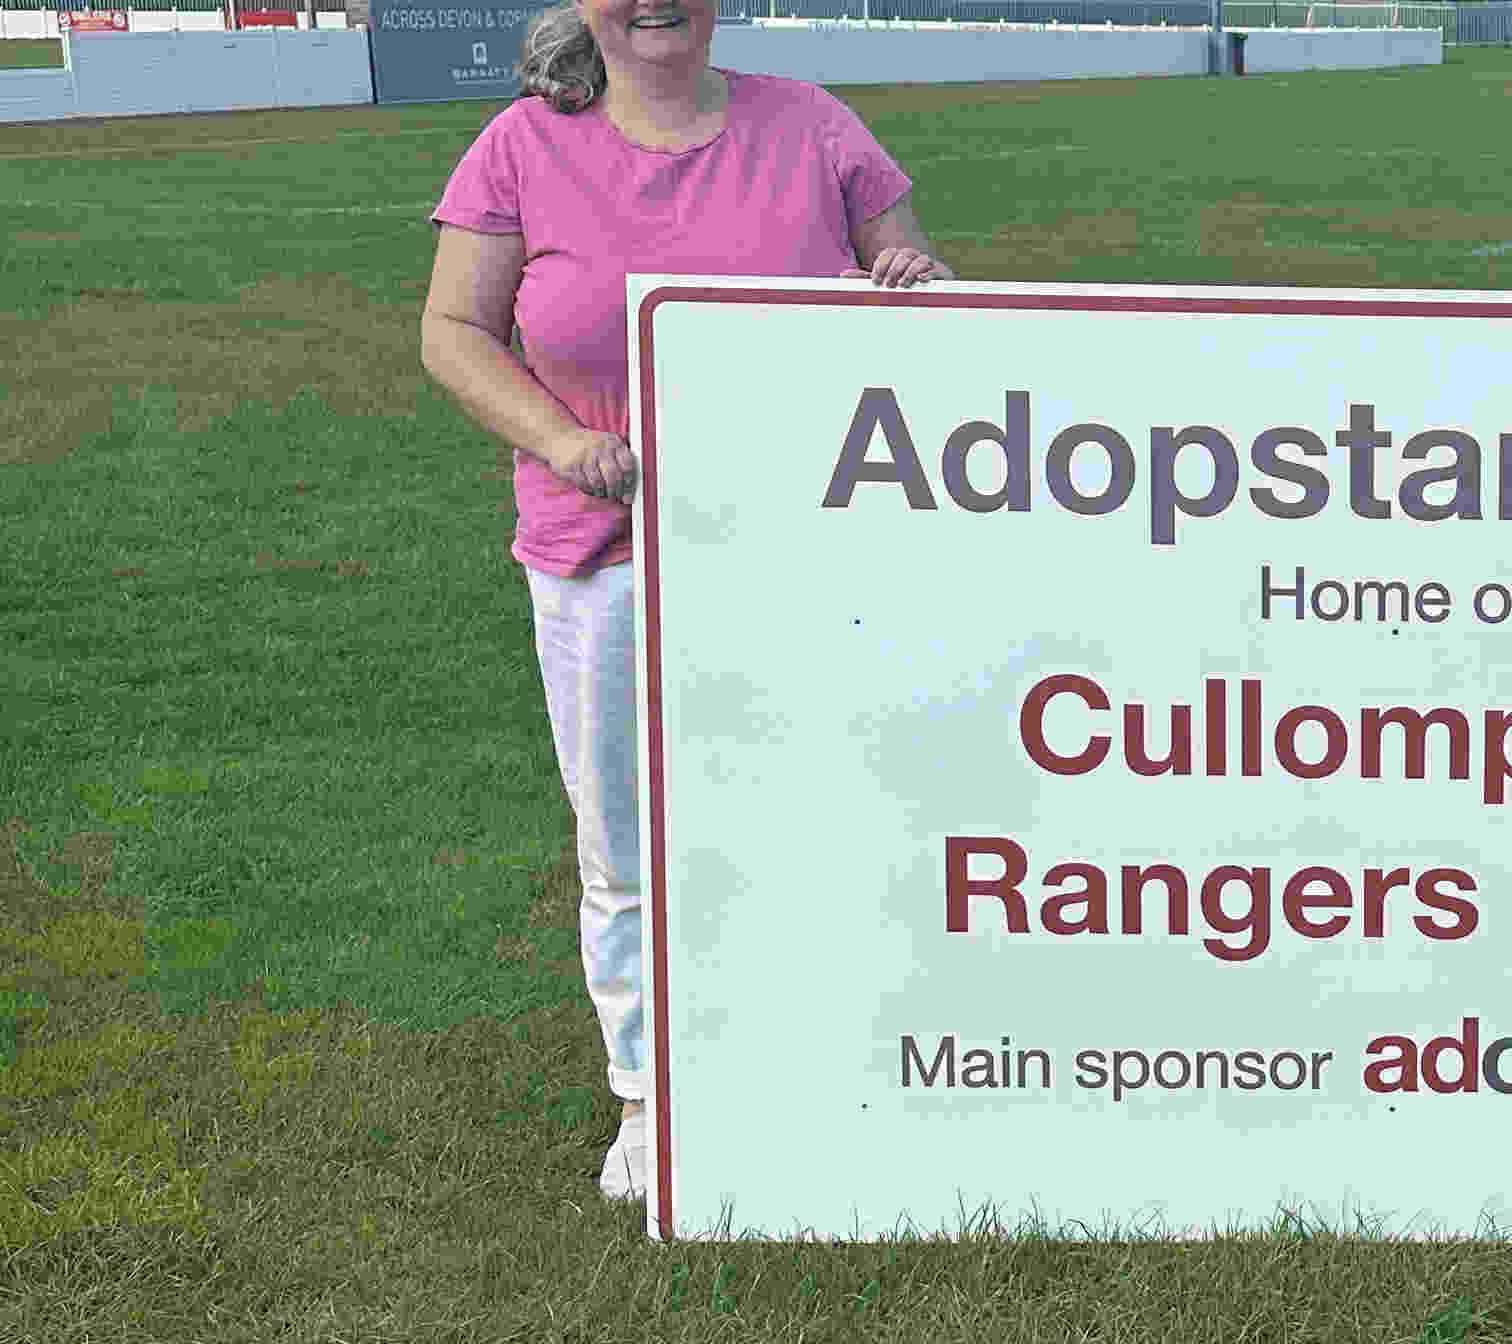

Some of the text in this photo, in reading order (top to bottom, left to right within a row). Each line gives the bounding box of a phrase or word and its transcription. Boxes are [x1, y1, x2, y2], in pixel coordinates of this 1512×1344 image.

[382, 8, 436, 29] ACROSS
[439, 8, 482, 29] DEVON
[1260, 565, 1452, 624] Home
[943, 835, 1479, 962] Rangers
[900, 1034, 1051, 1089] Main
[1075, 1049, 1334, 1102] sponsor
